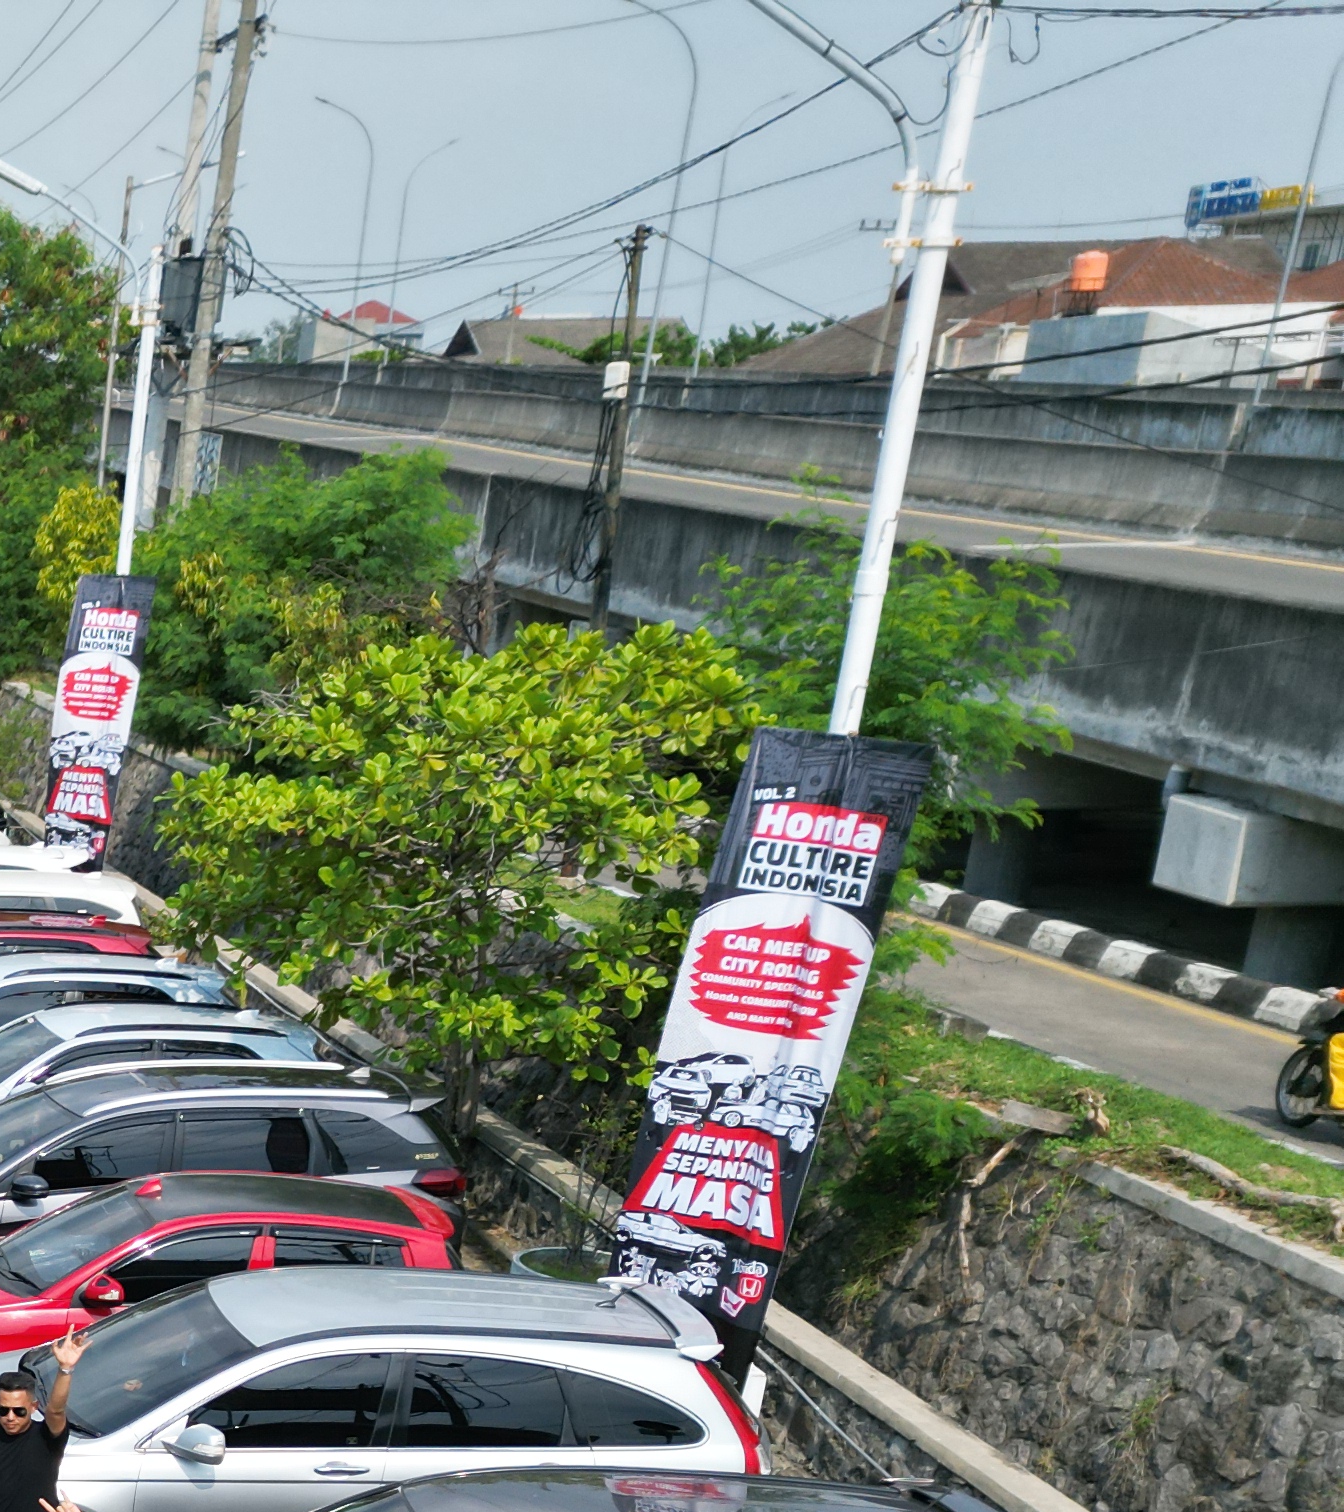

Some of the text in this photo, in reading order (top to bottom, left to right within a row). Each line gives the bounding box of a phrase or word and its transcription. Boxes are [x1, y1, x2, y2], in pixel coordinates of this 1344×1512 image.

[786, 786, 796, 799] 2
[757, 803, 882, 850] Honda
[742, 867, 861, 901] INDONSIA
[724, 934, 830, 963] CAR MEE UP
[721, 956, 760, 973] CITY
[700, 972, 763, 989] COMMUNITY
[705, 991, 740, 1003] Honda
[673, 1132, 775, 1170] MENYALA
[663, 1152, 774, 1193] SEPANJANG
[641, 1172, 775, 1238] MASA
